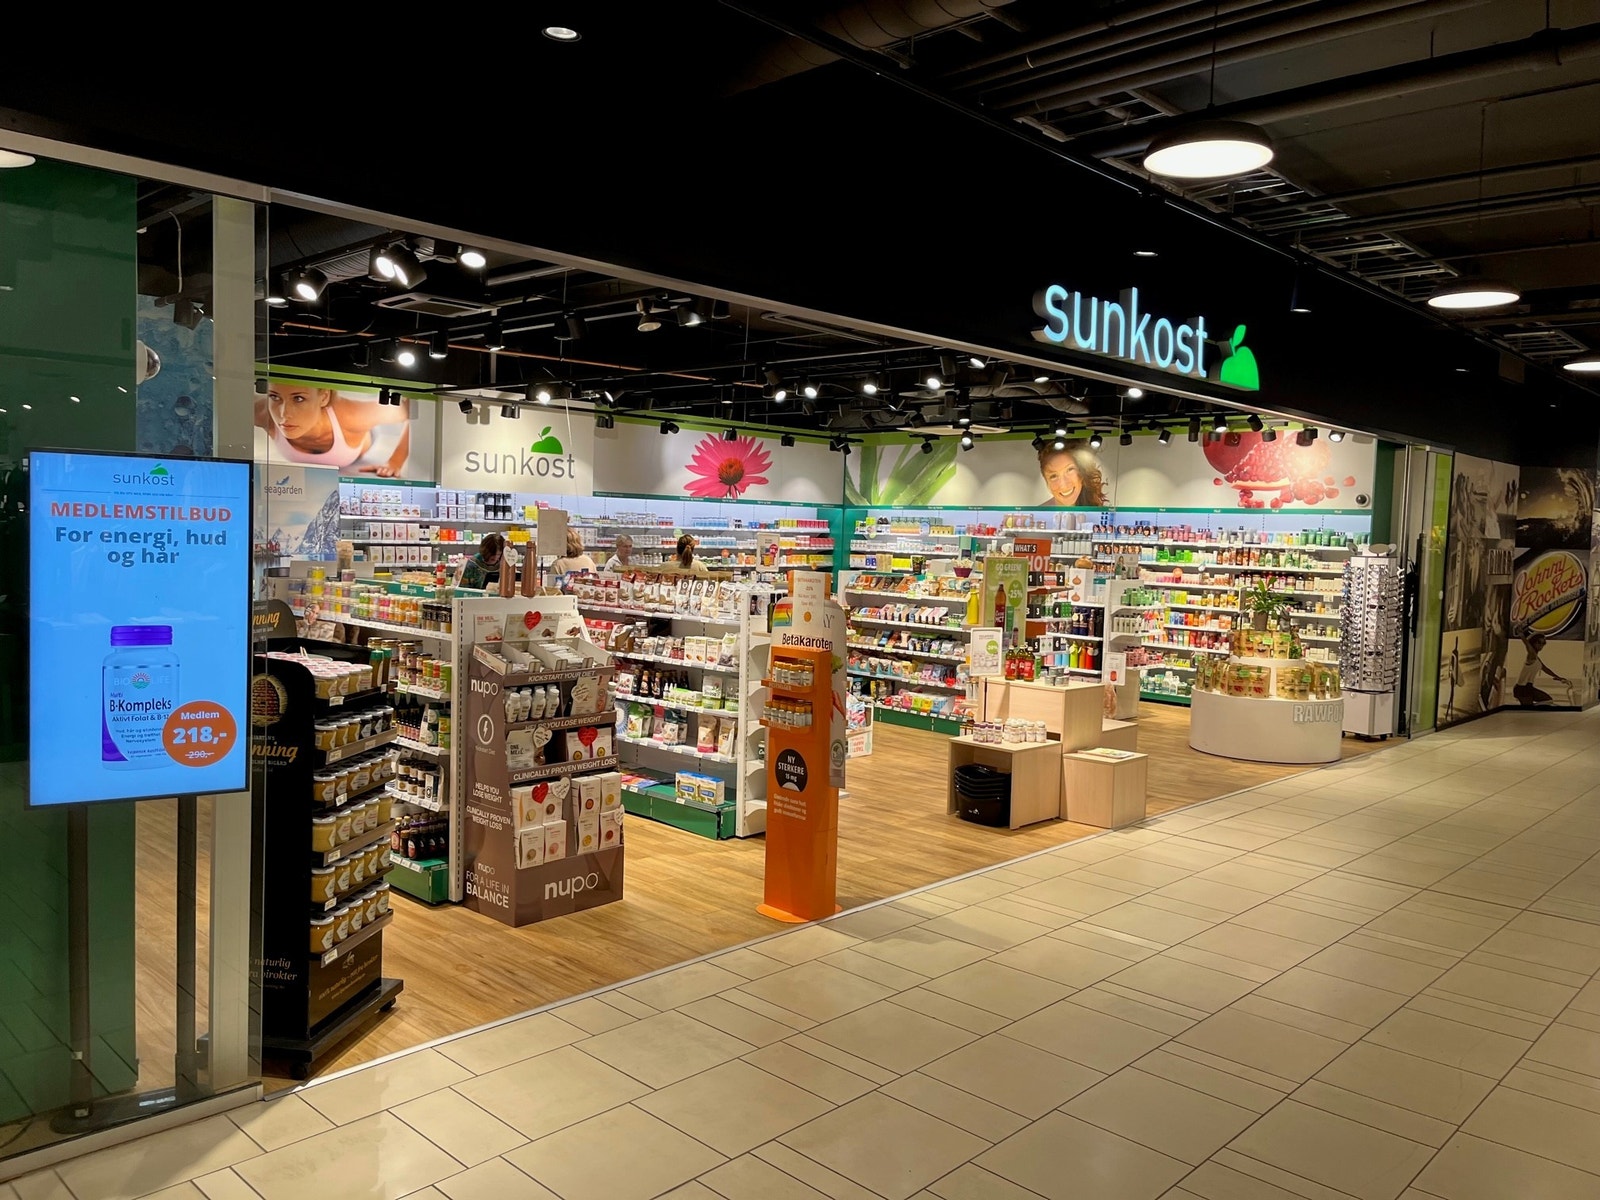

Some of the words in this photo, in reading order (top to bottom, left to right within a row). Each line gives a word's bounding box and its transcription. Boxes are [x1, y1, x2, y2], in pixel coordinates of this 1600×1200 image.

[1043, 284, 1208, 378] sunkost
[465, 448, 575, 479] sunkost
[112, 471, 175, 486] sunkost
[263, 485, 303, 496] seagarden
[51, 502, 232, 522] MEDLEMSTILBUD
[55, 527, 93, 543] For
[99, 529, 179, 549] energi,
[186, 529, 227, 546] hud
[107, 550, 135, 568] og
[141, 546, 180, 564] hår
[1027, 555, 1051, 572] HOT
[1519, 570, 1583, 620] Rockets
[782, 633, 834, 651] Betakaroten
[528, 672, 563, 683] KICKSTART
[564, 671, 581, 679] YOUR
[470, 678, 499, 697] nupo
[111, 715, 131, 723] Aktivt
[131, 714, 149, 722] Folat
[180, 711, 220, 720] Medlem
[547, 721, 560, 729] YOU
[561, 719, 578, 727] LOSE
[578, 715, 602, 724] WEIGHT
[1293, 704, 1343, 723] RAWPO
[173, 726, 228, 745] 218,-
[778, 761, 805, 776] STERKERE
[787, 755, 796, 764] NY
[513, 768, 550, 781] CLINICALLY
[551, 764, 578, 775] PROVEN
[577, 760, 601, 771] WEIGHT
[601, 757, 617, 766] LOSS
[472, 789, 485, 799] LOSE
[484, 792, 503, 804] WEIGHT
[475, 782, 488, 792] HELPS
[488, 786, 500, 796] YOU
[466, 805, 492, 819] CLINICALLY
[492, 812, 511, 825] PROVEN
[472, 814, 489, 827] WEIGHT
[489, 820, 503, 831] LOSS
[477, 863, 496, 876] nupo
[466, 870, 479, 884] FOR
[485, 878, 500, 892] LIFE
[500, 884, 509, 895] IN
[544, 872, 599, 900] nupo
[466, 882, 509, 909] BALANCE
[254, 957, 291, 970] naturlig
